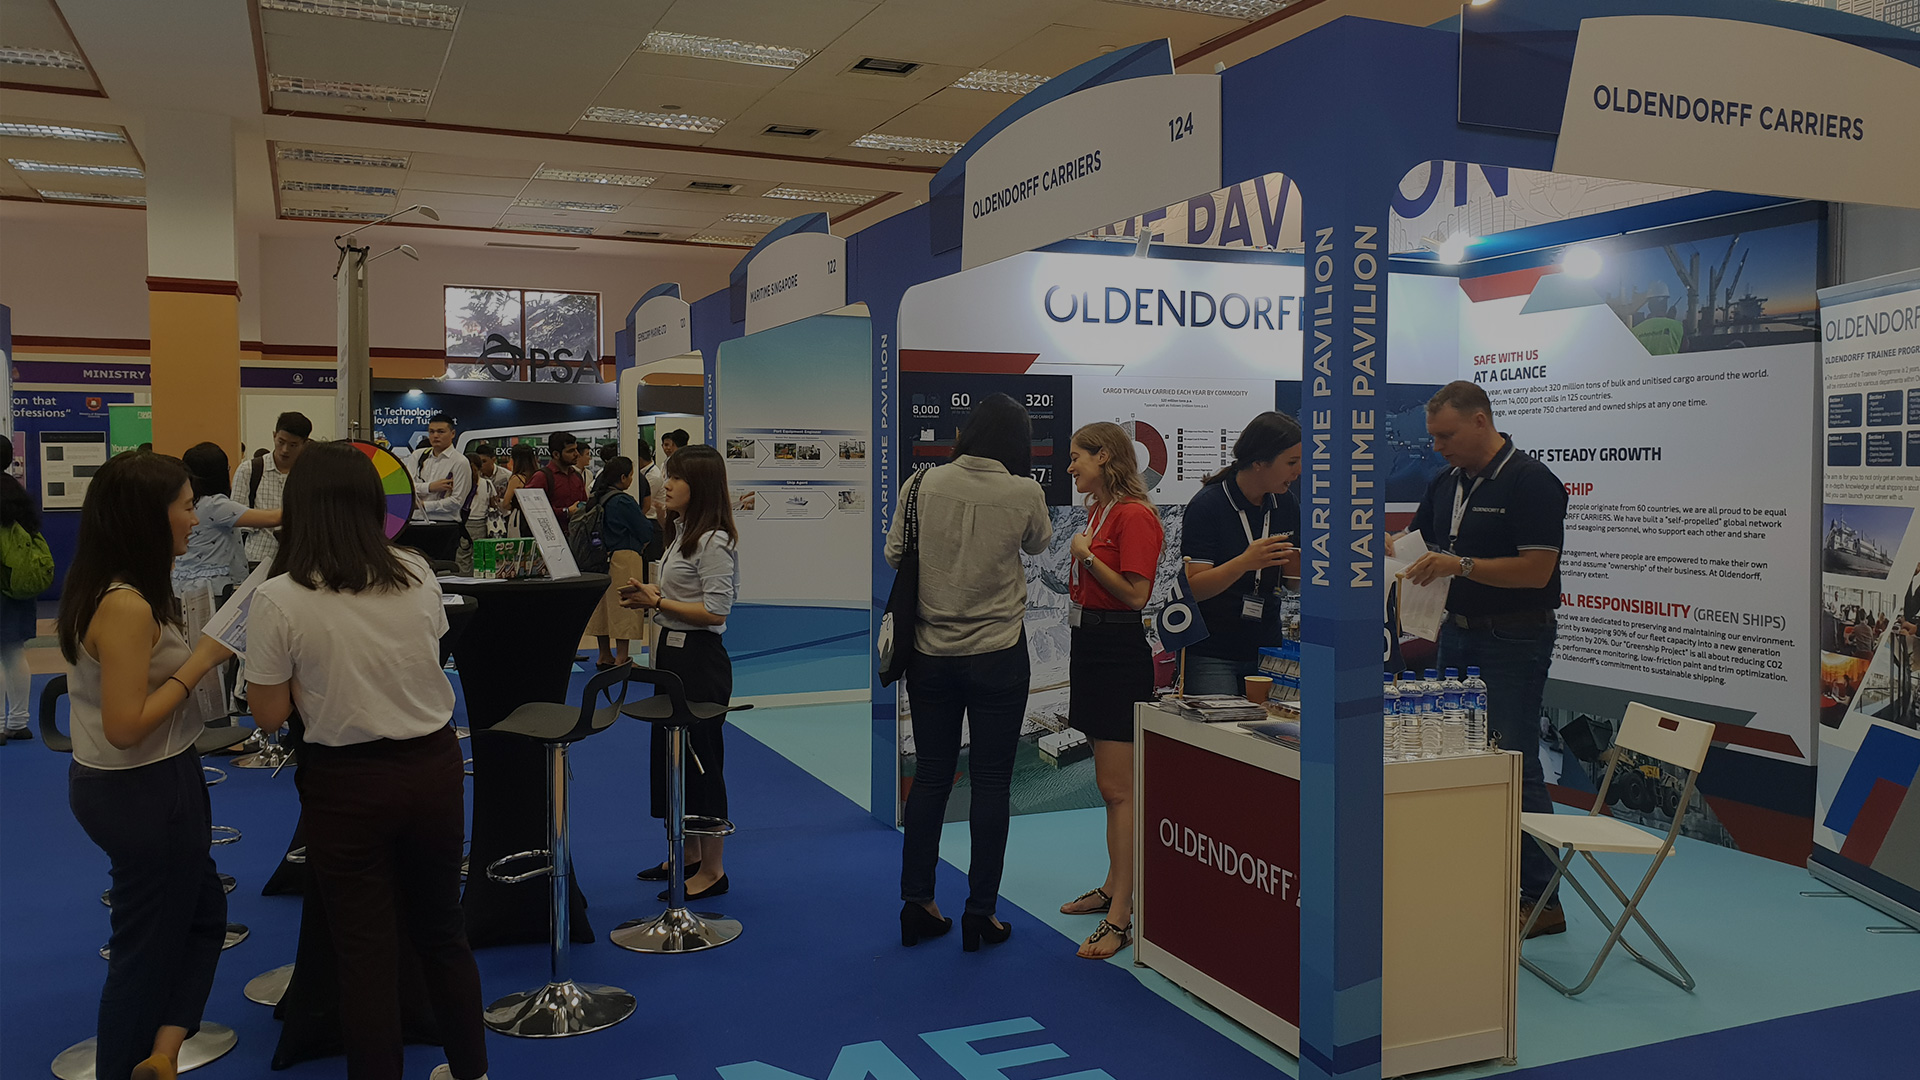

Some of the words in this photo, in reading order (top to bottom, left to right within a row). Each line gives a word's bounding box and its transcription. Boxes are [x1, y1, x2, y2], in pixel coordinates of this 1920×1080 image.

[1593, 84, 1753, 127] OLDENDORFF
[1759, 106, 1864, 141] CARRIERS
[1168, 111, 1194, 142] 124
[972, 175, 1039, 219] OLDENDORFF
[1042, 150, 1102, 192] CARRIERS
[827, 258, 837, 275] 122
[750, 284, 770, 304] MARITIME
[771, 273, 798, 296] SINGAPORE
[1313, 226, 1334, 397] PAVILION
[1352, 225, 1377, 396] PAVILION
[1473, 354, 1497, 366] SAFE
[1498, 351, 1524, 364] WITH
[1525, 349, 1539, 360] US
[1825, 352, 1865, 365] OLDENDORFF
[1867, 348, 1897, 359] TRAINEE
[1897, 345, 1920, 355] PROGR
[83, 369, 146, 379] MINISTRY
[530, 348, 605, 384] PSA
[1473, 370, 1488, 383] AT
[1489, 369, 1498, 383] A
[1500, 365, 1547, 381] GLANCE
[880, 333, 888, 429] PAVILION
[1512, 387, 1529, 395] carry
[1529, 385, 1548, 393] about
[1562, 382, 1585, 390] million
[1611, 378, 1626, 387] bulk
[1642, 376, 1672, 386] unitised
[1673, 376, 1695, 385] cargo
[1696, 372, 1725, 382] around
[1726, 371, 1740, 380] the
[1741, 369, 1769, 379] world.
[32, 396, 57, 405] that
[951, 393, 971, 407] 60
[1025, 394, 1050, 407] 320
[1490, 398, 1508, 406] rform
[1508, 397, 1529, 406] 14,000
[1529, 396, 1543, 405] port
[1543, 395, 1559, 403] calls
[1567, 393, 1579, 401] 125
[1579, 391, 1613, 400] countries.
[1492, 410, 1507, 418] rage,
[1517, 408, 1542, 417] operate
[1542, 406, 1555, 414] 750
[1555, 404, 1587, 413] chartered
[1602, 402, 1626, 411] owned
[1627, 402, 1647, 411] ships
[1688, 398, 1708, 406] time.
[13, 408, 71, 418] ofessions"
[912, 405, 940, 415] 8,000
[373, 415, 399, 427] loyed
[401, 415, 414, 425] for
[416, 416, 431, 425] Tua
[1530, 449, 1544, 460] OF
[1547, 448, 1596, 462] STEADY
[1599, 447, 1662, 461] GROWTH
[880, 435, 889, 534] MARITIME
[1564, 482, 1594, 496] SHIP
[1311, 409, 1331, 587] MARITIME
[1350, 410, 1375, 588] MARITIME
[1569, 503, 1590, 512] people
[1590, 504, 1619, 512] originate
[1620, 504, 1636, 512] from
[1637, 504, 1646, 512] 60
[1647, 505, 1681, 514] countries,
[1719, 507, 1741, 516] proud
[1764, 508, 1787, 517] equal
[1581, 514, 1613, 522] CARRIERS.
[1723, 518, 1747, 528] global
[1748, 519, 1782, 528] network
[1577, 524, 1606, 533] seagoing
[1658, 527, 1686, 536] support
[1687, 529, 1705, 537] each
[1706, 529, 1727, 537] other
[1743, 531, 1766, 540] share
[1621, 553, 1644, 561] people
[1657, 555, 1699, 565] empowered
[1731, 559, 1749, 567] their
[1751, 561, 1768, 569] own
[1562, 570, 1587, 578] ordinary
[1588, 571, 1609, 579] extent.
[1656, 566, 1673, 574] their
[1674, 568, 1707, 576] business.
[1718, 570, 1762, 581] Oldendorff,
[1560, 593, 1575, 606] AL
[1577, 594, 1691, 618] RESPONSIBILITY
[1694, 607, 1739, 624] (GREEN
[1742, 613, 1786, 631] SHIPS)
[1557, 622, 1572, 631] print
[1581, 626, 1612, 637] swapping
[1649, 633, 1665, 643] fleet
[1667, 637, 1697, 648] capacity
[1697, 640, 1712, 648] into
[1719, 643, 1736, 651] new
[1737, 645, 1781, 657] generation
[1591, 616, 1622, 626] dedicated
[1631, 620, 1667, 633] preserving
[1683, 626, 1726, 640] maintaining
[1741, 635, 1795, 647] environment.
[1557, 634, 1584, 642] sumption
[1610, 639, 1622, 647] Our
[1708, 653, 1730, 662] about
[1731, 656, 1765, 668] reducing
[1766, 659, 1783, 669] CO2
[1562, 644, 1602, 655] performance
[1640, 653, 1681, 667] low-friction
[1683, 660, 1701, 669] paint
[1718, 666, 1734, 674] trim
[1735, 668, 1788, 682] optimization.
[1600, 660, 1642, 672] commitment
[1651, 666, 1692, 680] sustainable
[1692, 672, 1726, 686] shipping.
[1159, 817, 1293, 901] OLDENDORFF
